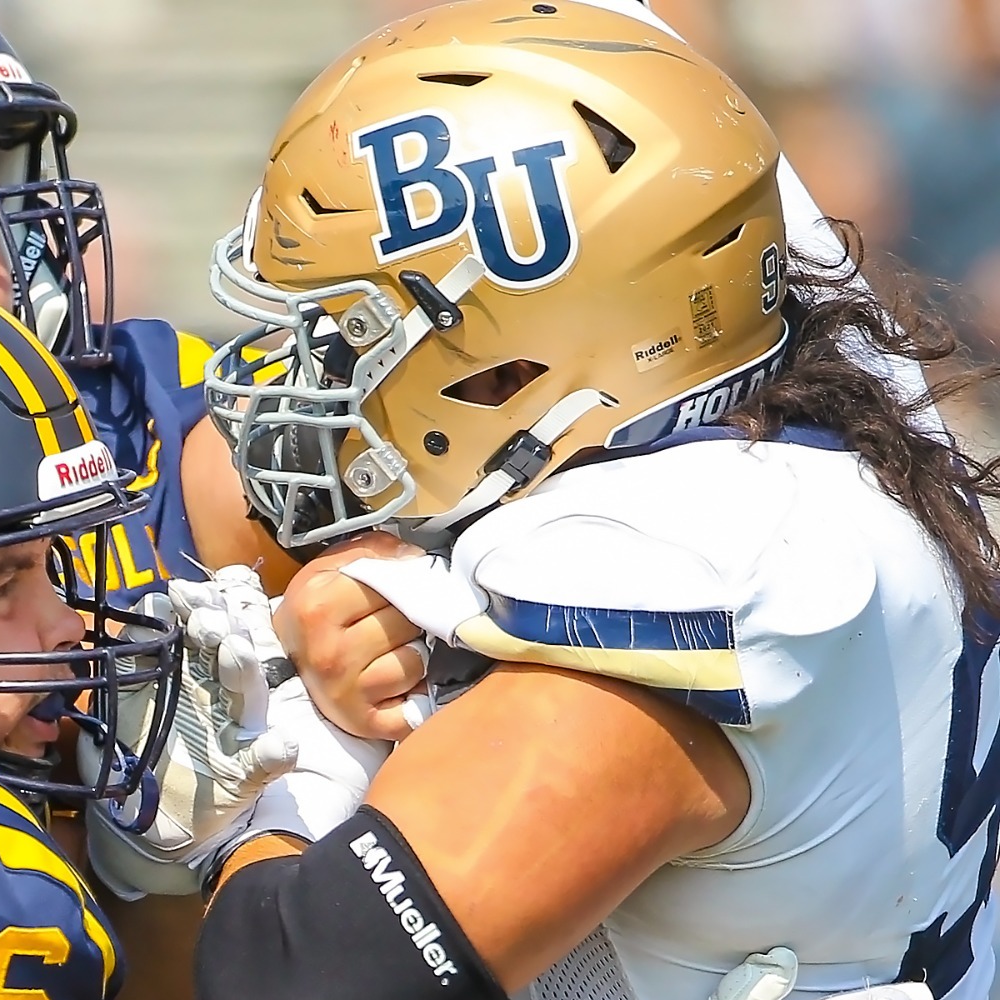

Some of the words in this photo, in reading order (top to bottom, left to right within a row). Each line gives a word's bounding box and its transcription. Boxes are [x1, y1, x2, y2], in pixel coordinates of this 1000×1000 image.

[355, 110, 578, 288] BU
[634, 334, 679, 361] Riddell
[55, 447, 113, 487] Riddell
[371, 853, 458, 977] Mueller
